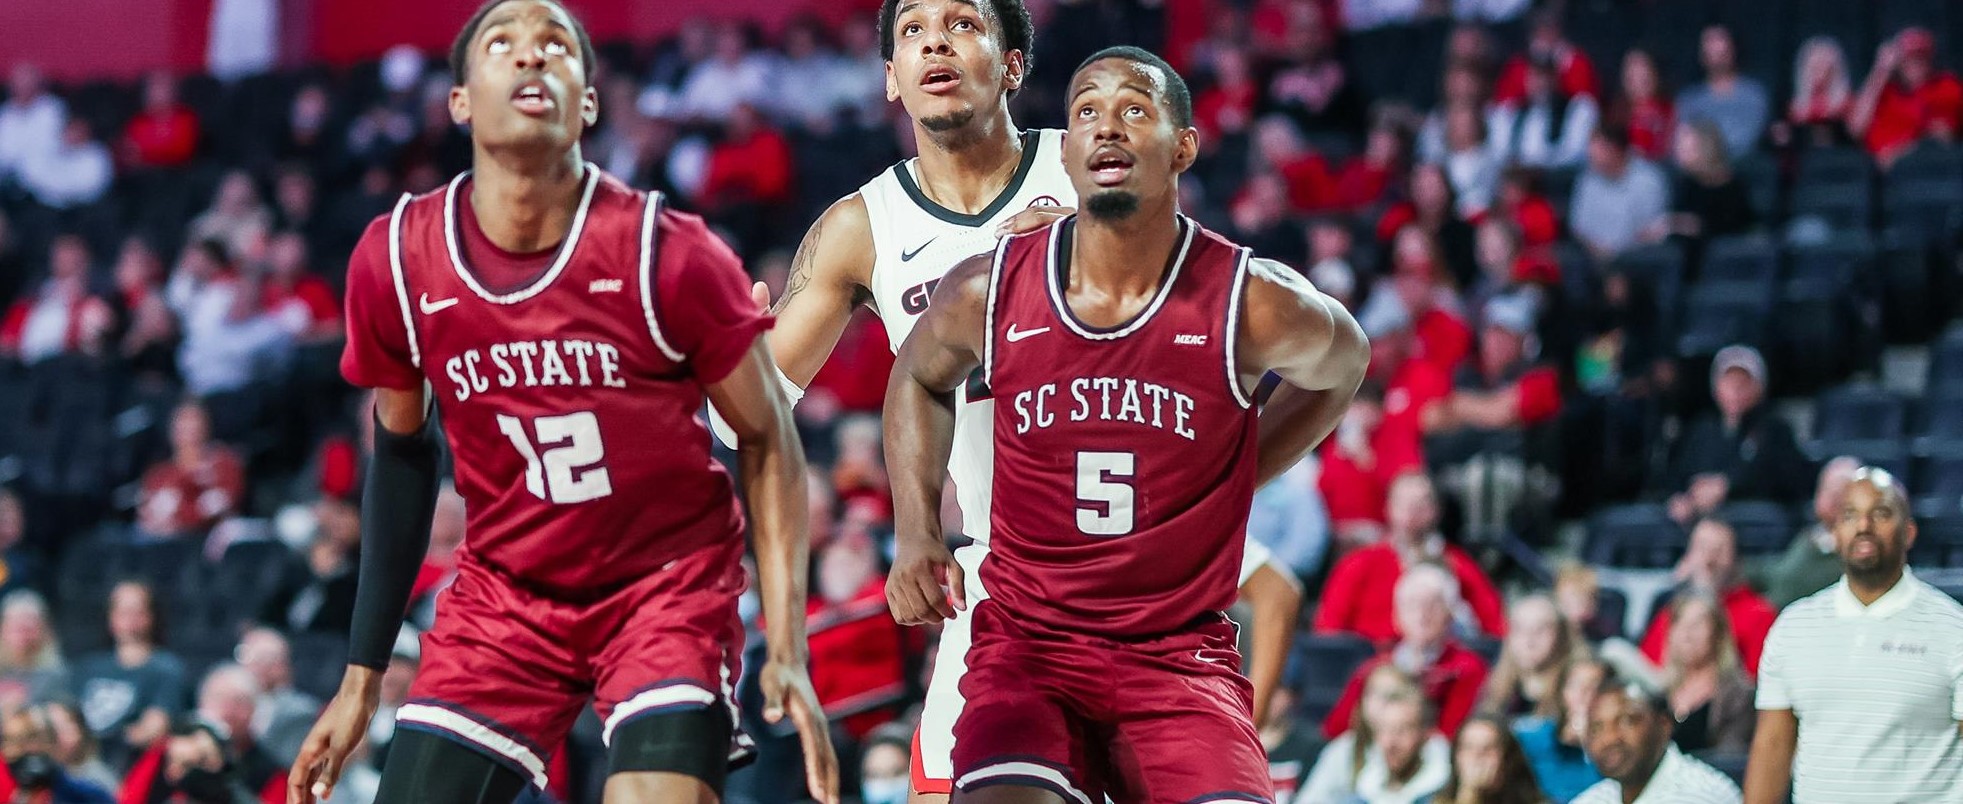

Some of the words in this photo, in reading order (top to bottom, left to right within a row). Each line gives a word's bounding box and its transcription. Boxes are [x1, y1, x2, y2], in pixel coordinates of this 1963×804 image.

[901, 277, 942, 316] G
[445, 349, 489, 402] SC
[490, 339, 627, 389] STATE
[1174, 334, 1207, 345] MEAC
[1014, 383, 1056, 434] SC
[1070, 377, 1195, 440] STATE
[496, 410, 613, 504] 12
[1075, 451, 1134, 535] 5
